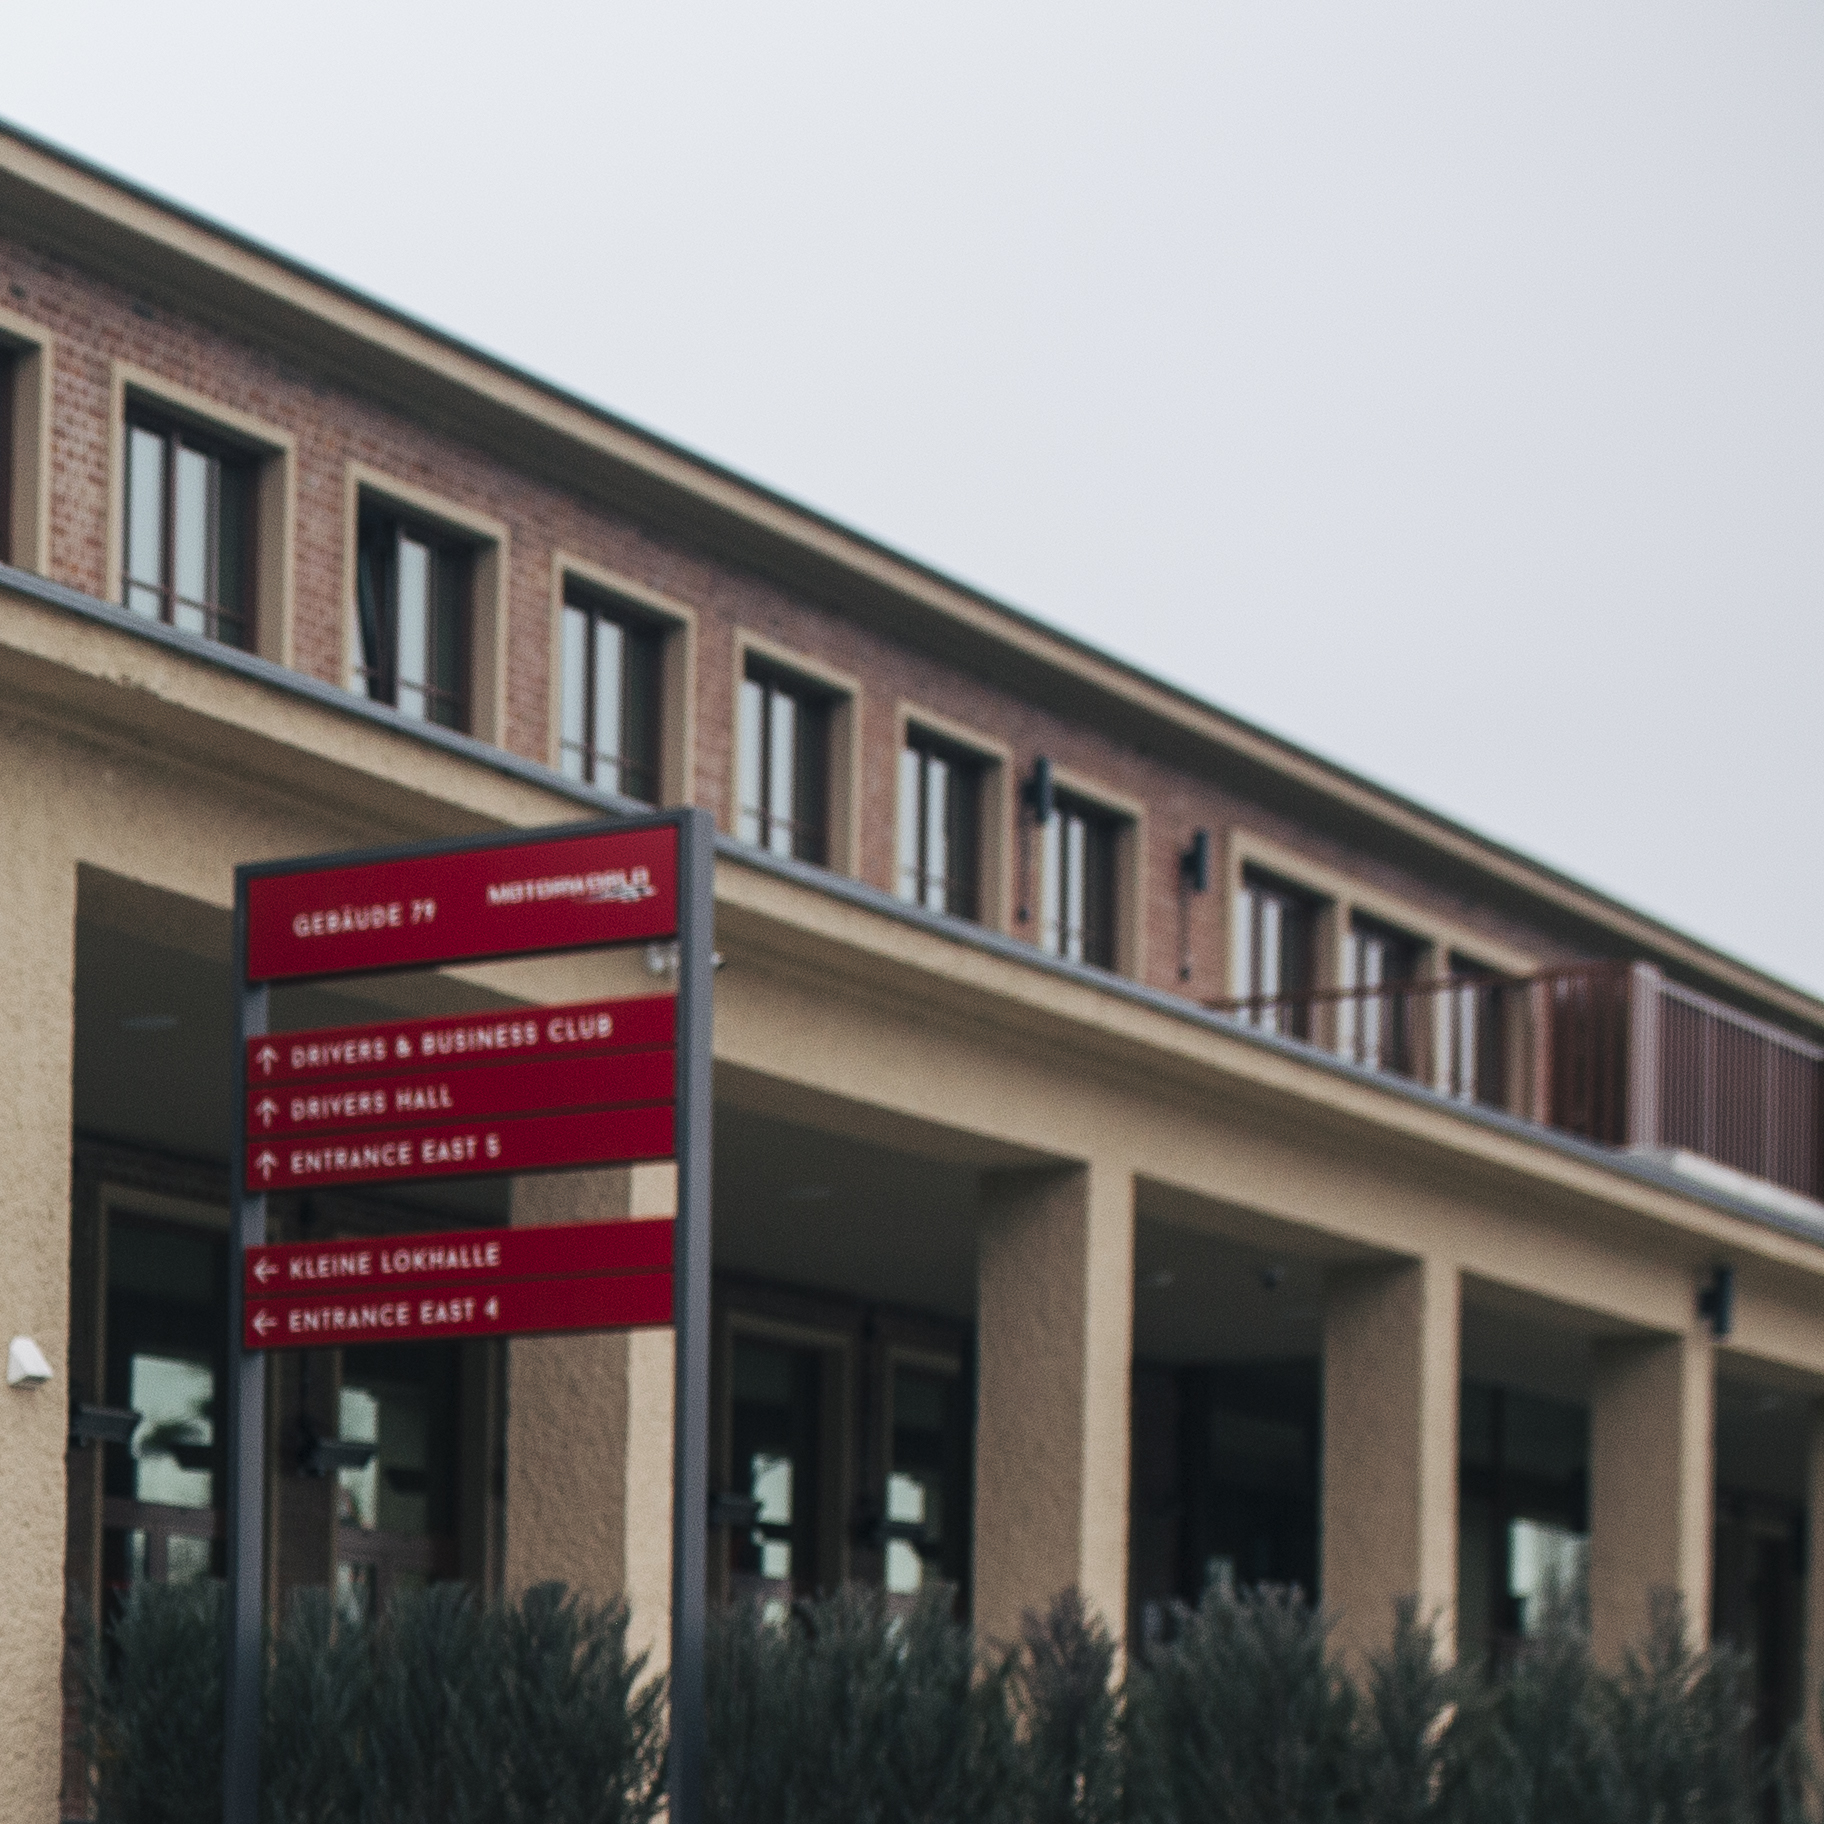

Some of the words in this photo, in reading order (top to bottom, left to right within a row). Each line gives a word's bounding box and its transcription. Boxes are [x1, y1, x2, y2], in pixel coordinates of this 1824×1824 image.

[292, 902, 403, 938] GEBÄUDE
[290, 1036, 387, 1069] DRIVERS
[395, 1034, 413, 1059] &
[420, 1020, 538, 1056] BUSINESS
[547, 1012, 614, 1043] CLUB
[290, 1089, 387, 1122] DRIVERS
[395, 1083, 453, 1112] HALL
[290, 1141, 413, 1174] ENTRANCE
[420, 1135, 478, 1164] EAST
[288, 1251, 373, 1280] KLEINE
[380, 1241, 501, 1274] LOKHALLE
[288, 1301, 412, 1333] ENTRANCE
[419, 1297, 476, 1325] EAST
[483, 1295, 500, 1321] 4
